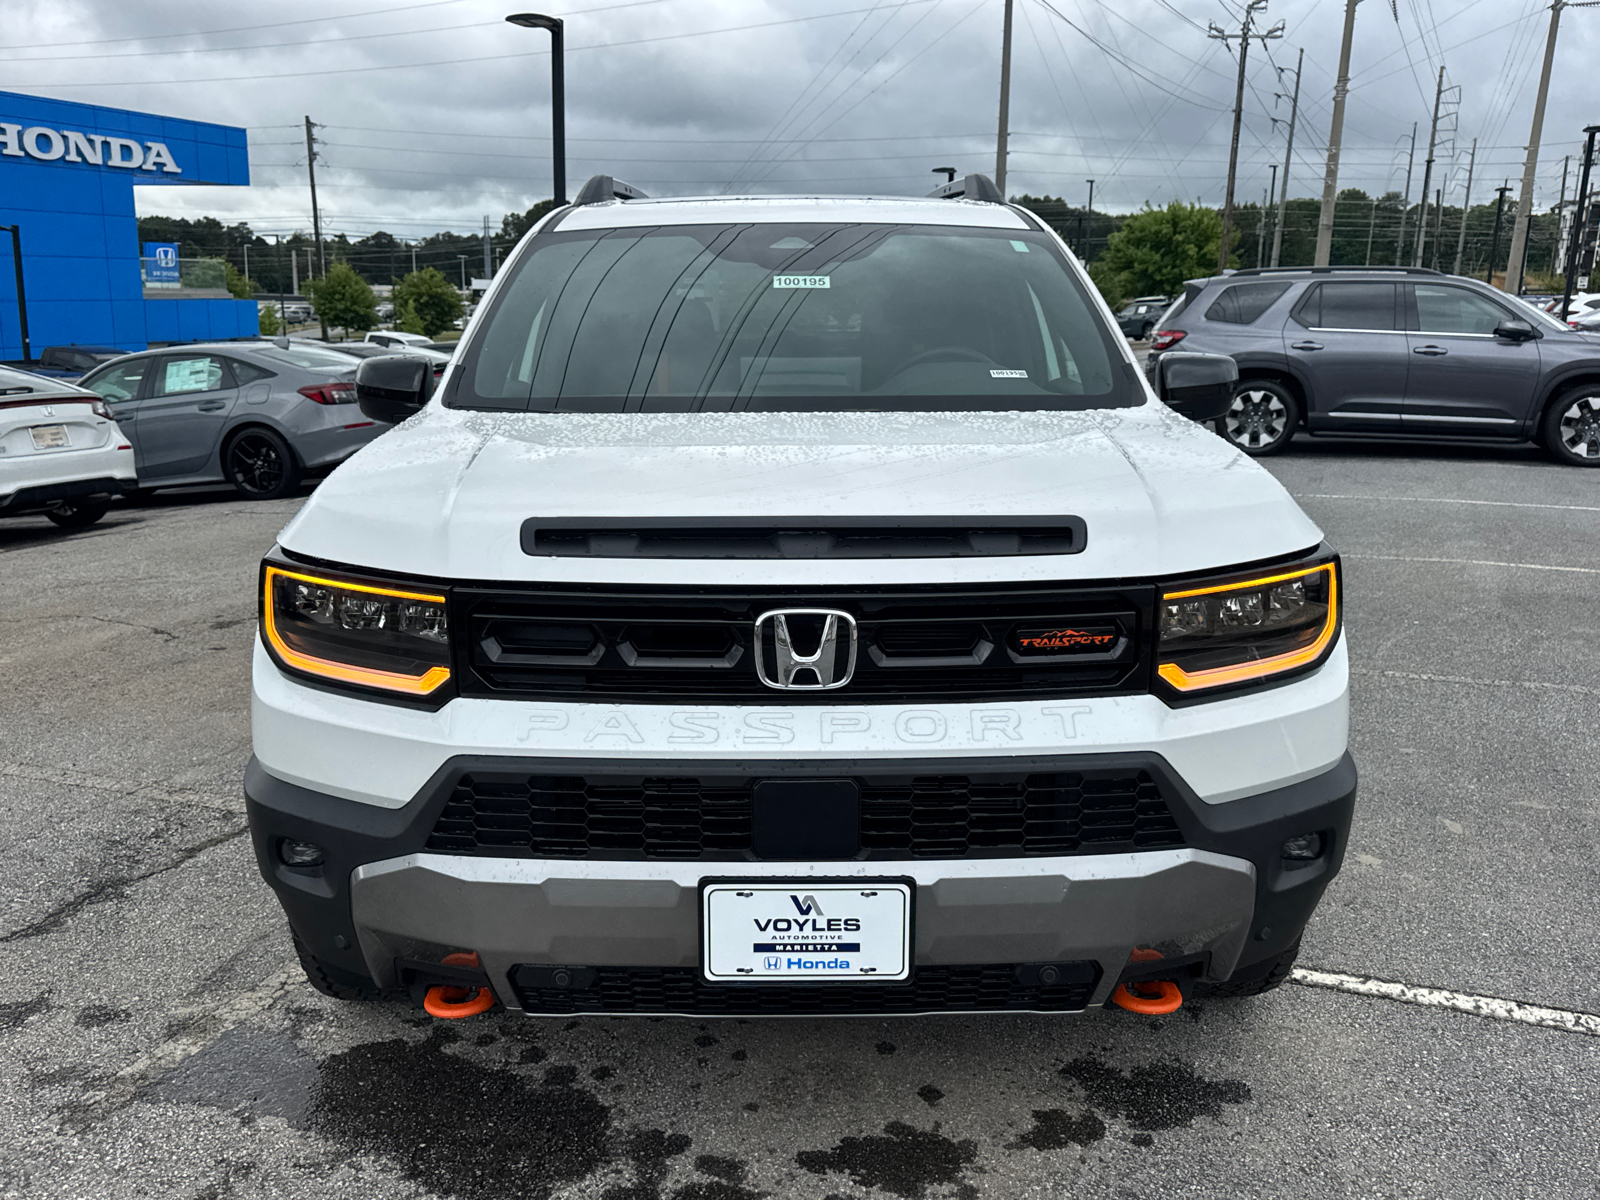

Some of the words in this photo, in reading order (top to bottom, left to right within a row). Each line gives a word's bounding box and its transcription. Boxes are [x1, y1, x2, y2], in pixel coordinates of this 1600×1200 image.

[0, 122, 182, 173] HONDA
[776, 277, 826, 286] 100195
[1020, 635, 1113, 647] TRAILSPORT
[517, 705, 1092, 745] PASSPORT
[753, 918, 861, 932] VOYLES
[786, 957, 850, 969] Honda
